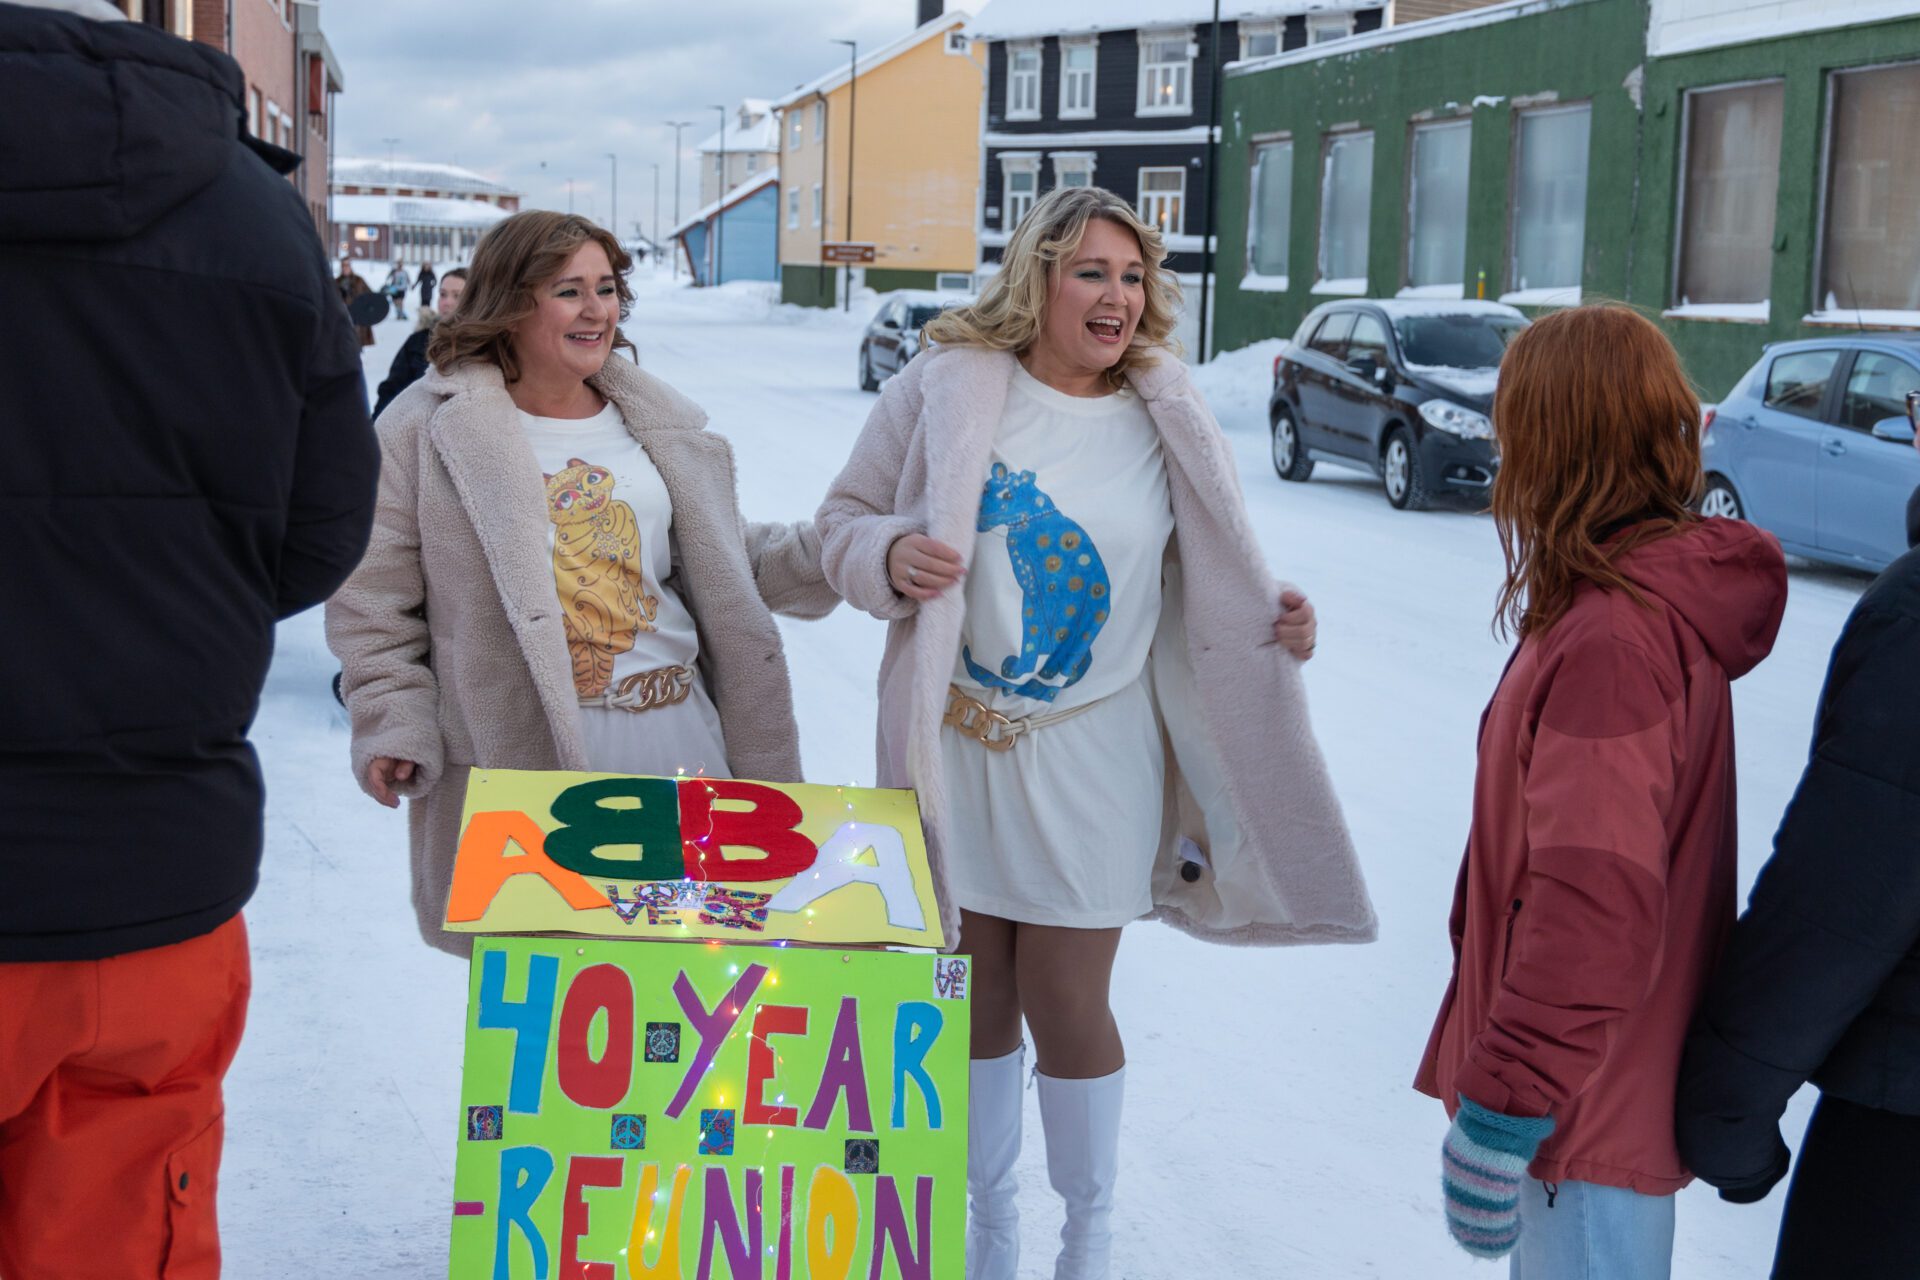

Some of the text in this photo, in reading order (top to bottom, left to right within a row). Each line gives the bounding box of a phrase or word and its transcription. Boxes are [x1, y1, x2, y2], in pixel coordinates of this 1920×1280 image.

[447, 777, 926, 931] ABBA
[479, 950, 943, 1132] 40 YEAR
